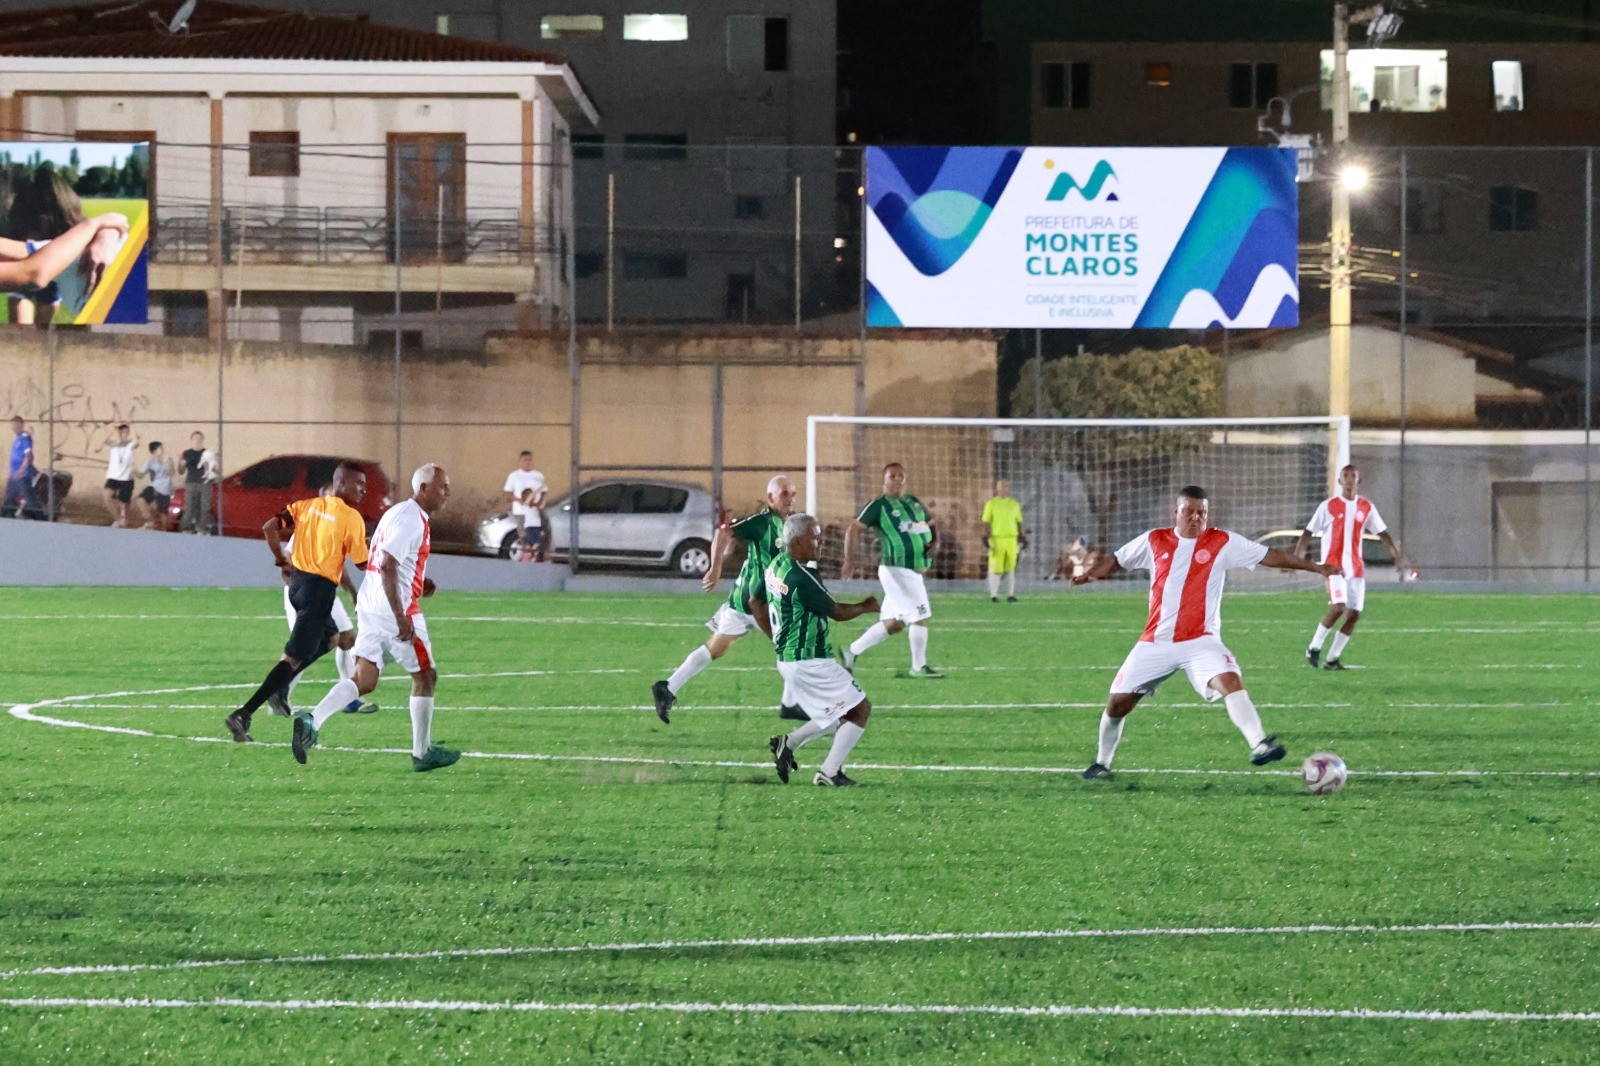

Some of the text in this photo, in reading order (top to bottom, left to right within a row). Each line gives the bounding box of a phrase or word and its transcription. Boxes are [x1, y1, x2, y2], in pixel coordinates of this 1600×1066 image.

[1025, 216, 1138, 229] PREFEITURA DE
[1026, 233, 1138, 252] MONTES
[1026, 256, 1138, 276] CLAROS
[1026, 295, 1065, 304] CIDADE
[1049, 308, 1055, 317] E
